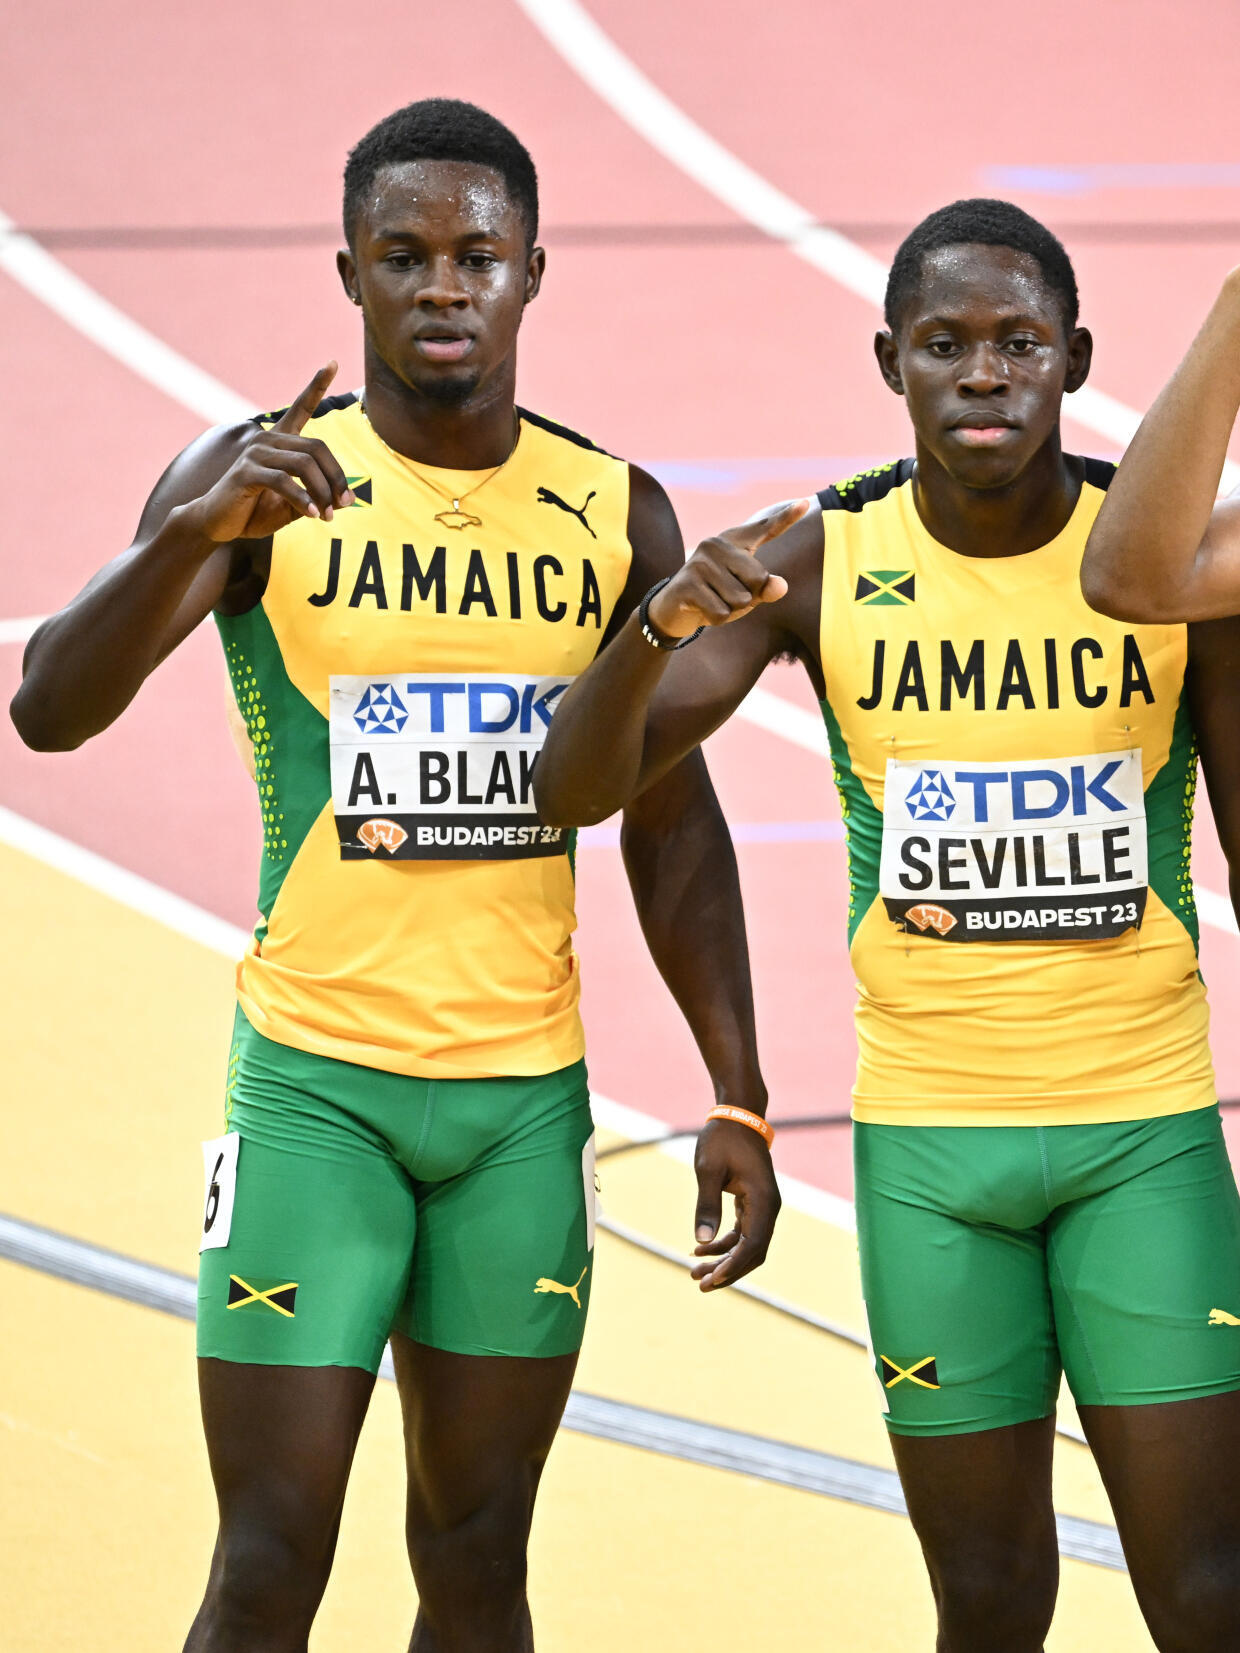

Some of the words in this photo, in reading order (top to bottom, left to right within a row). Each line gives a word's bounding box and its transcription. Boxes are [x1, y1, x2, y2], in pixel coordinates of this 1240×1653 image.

[307, 538, 601, 629] JAMAICA
[856, 634, 1155, 712] JAMAICA
[407, 682, 570, 734] TDK
[347, 752, 397, 807] A.
[954, 760, 1128, 823] TDK
[416, 826, 540, 846] BUDAPEST
[541, 825, 562, 843] 23
[898, 826, 1133, 891] SEVILLE
[966, 906, 1107, 930] BUDAPEST
[1110, 903, 1138, 923] 23
[204, 1152, 224, 1234] 6
